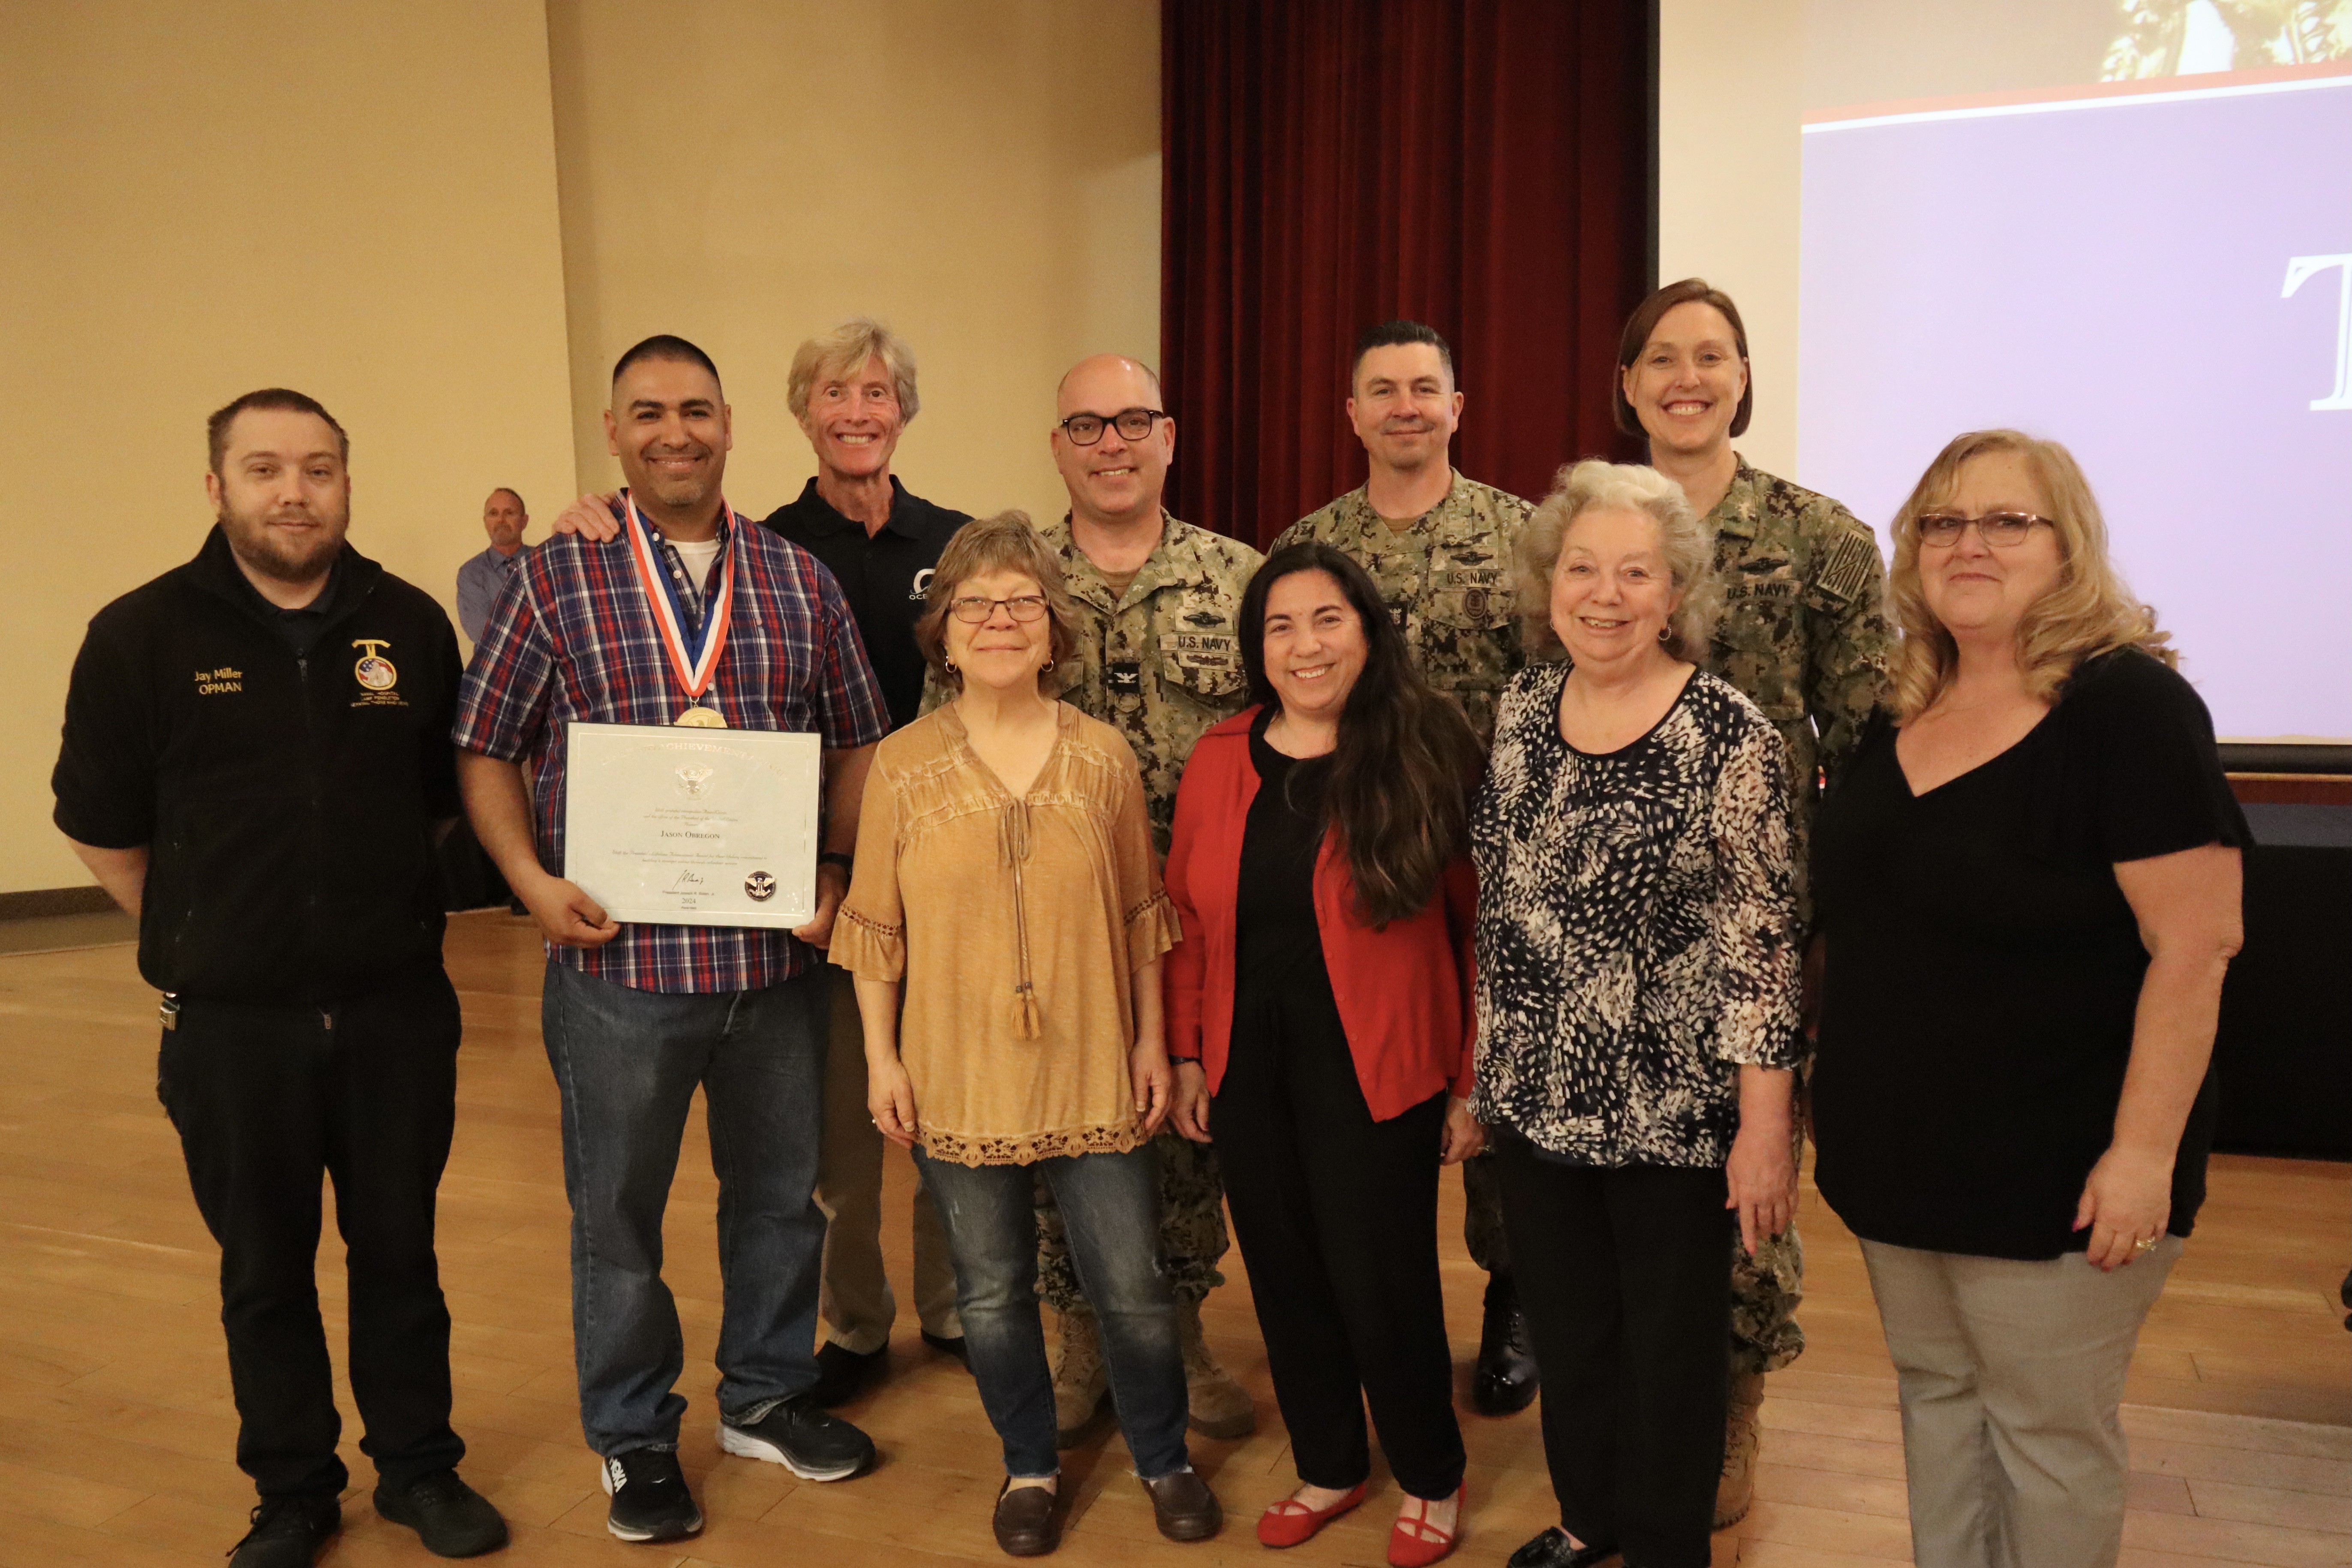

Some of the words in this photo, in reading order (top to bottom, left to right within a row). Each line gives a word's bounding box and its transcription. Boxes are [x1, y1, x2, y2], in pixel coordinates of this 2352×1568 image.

[1447, 572, 1466, 584] U.S.
[1470, 572, 1497, 585] NAVY
[1727, 586, 1751, 599] U.S.
[1755, 583, 1790, 598] NAVY
[1178, 636, 1199, 649] U.S.
[1202, 637, 1231, 651] NAVY
[195, 671, 211, 683] Jay
[214, 667, 243, 679] Miller
[199, 682, 242, 695] OPMAN
[660, 743, 747, 758] ACHIEVEMENT
[609, 1456, 628, 1493] HOKA
